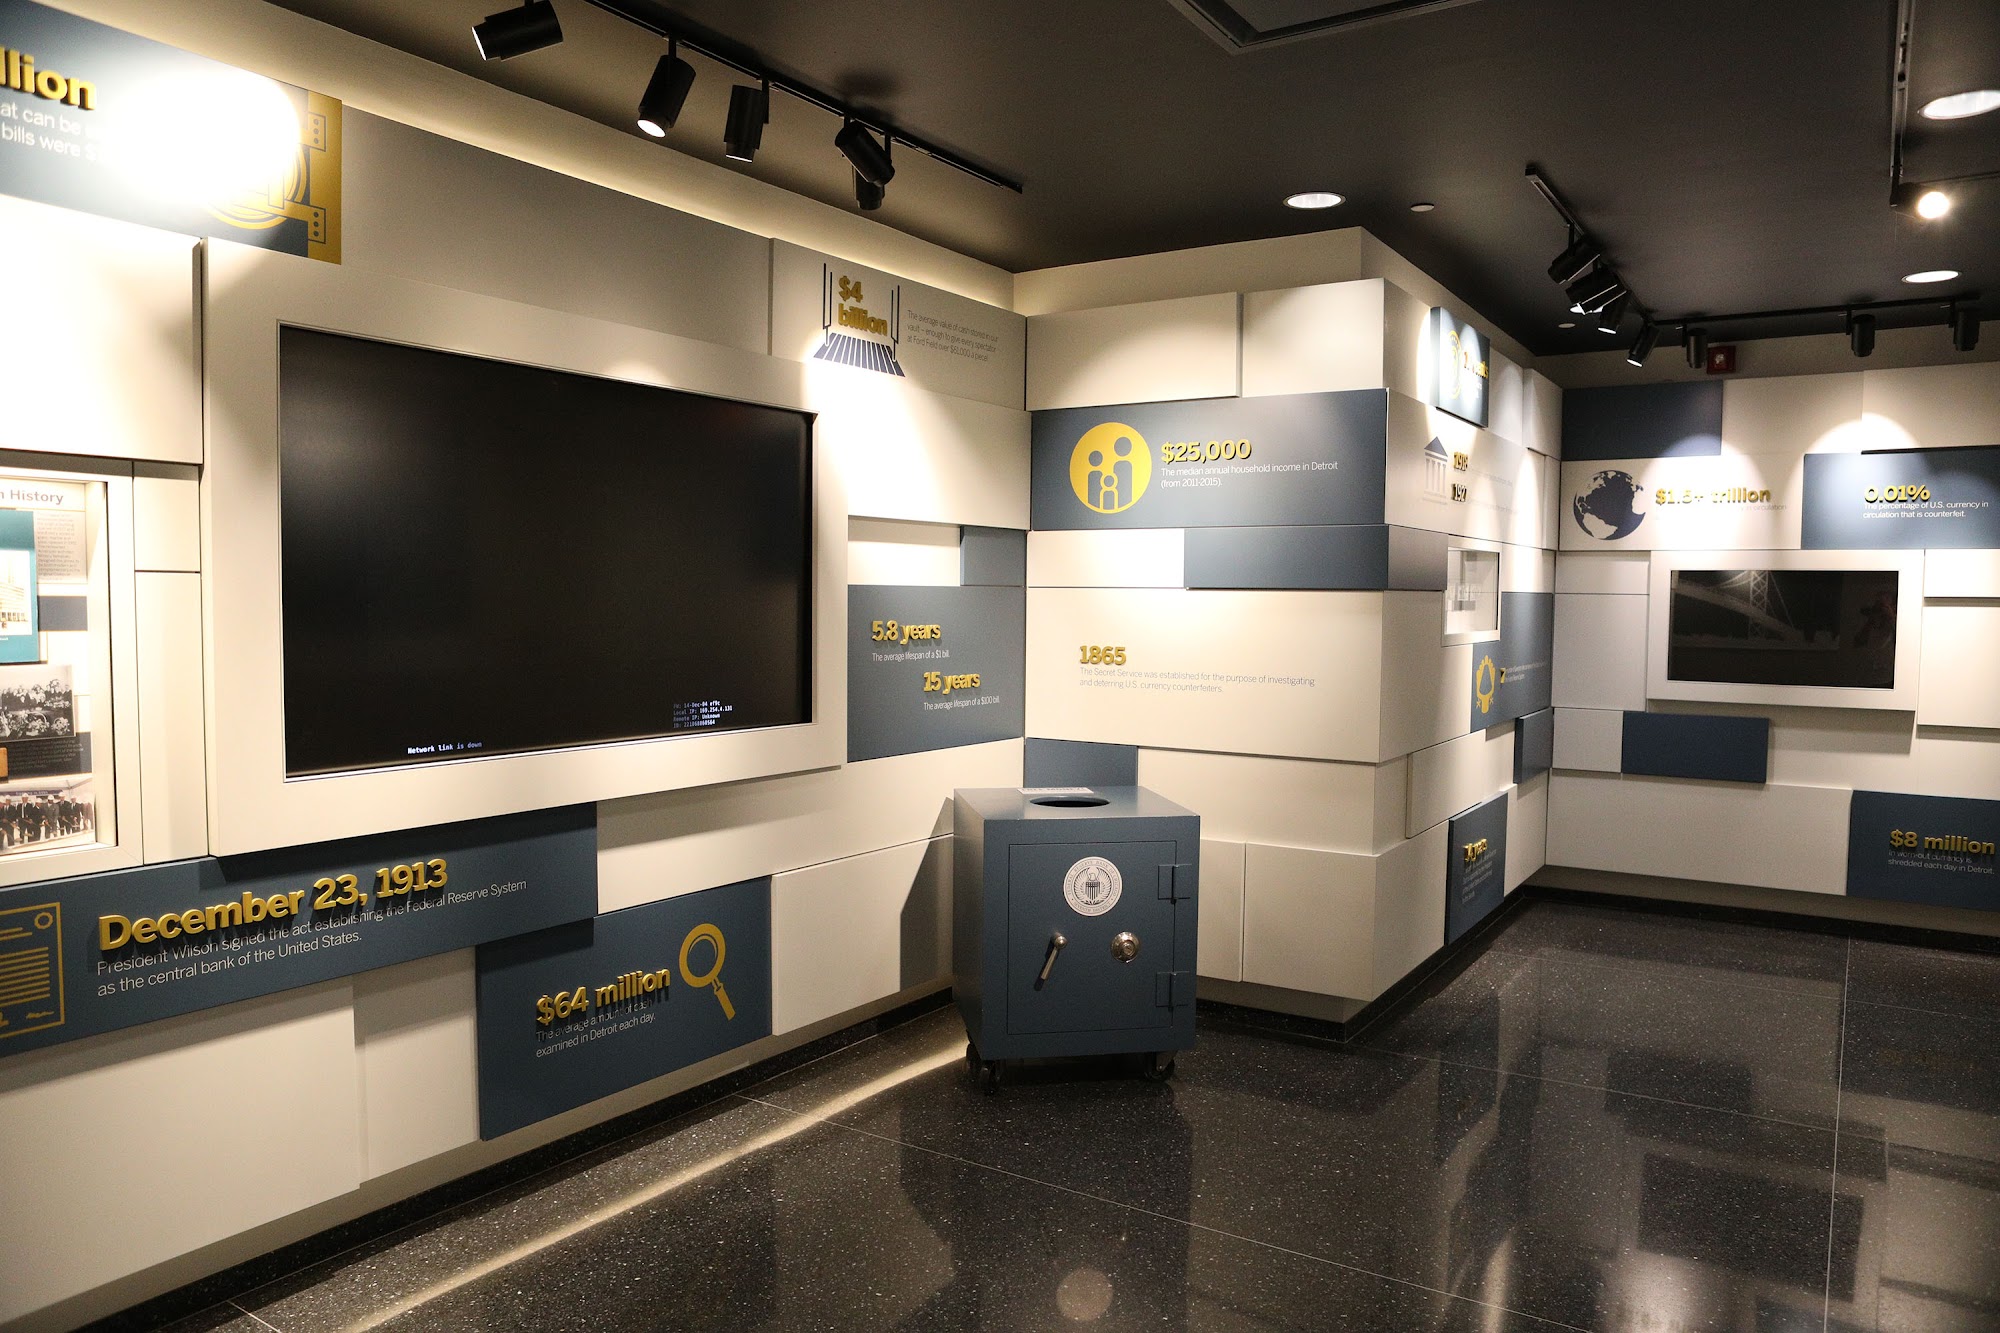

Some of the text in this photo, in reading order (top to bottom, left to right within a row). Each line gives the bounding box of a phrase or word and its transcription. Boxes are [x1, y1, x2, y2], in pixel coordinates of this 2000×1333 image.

[23, 108, 55, 129] can
[60, 114, 80, 135] be
[2, 122, 35, 146] bills
[40, 135, 80, 157] were
[839, 275, 863, 303] $4
[838, 303, 887, 337] billion
[907, 310, 918, 321] The
[918, 314, 938, 328] average
[939, 319, 952, 330] value
[953, 324, 958, 332] of
[959, 326, 970, 335] cash
[970, 329, 985, 340] stored
[907, 323, 997, 353] vault enough to give every spectator
[907, 335, 913, 343] at
[913, 336, 925, 346] Ford
[926, 339, 938, 350] Field
[939, 343, 949, 352] over
[1161, 439, 1252, 464] $25,000
[1161, 461, 1338, 477] The median annual household income in Detroit
[1160, 477, 1223, 489] (from 2011-2015).
[1864, 484, 1931, 503] 0.01%
[10, 489, 64, 505] History
[1711, 487, 1771, 503] trillion
[1879, 501, 1919, 510] percentage
[1920, 501, 1928, 509] of
[1930, 501, 1945, 509] U.S.
[1946, 501, 1980, 509] currency
[1981, 500, 1989, 508] in
[1863, 510, 1966, 519] circulation that is counterfeit.
[872, 620, 941, 645] 5.8 years
[872, 652, 883, 662] The
[883, 652, 904, 662] average
[905, 651, 924, 661] lifespan
[925, 650, 931, 659] of
[935, 649, 941, 659] $1
[1080, 645, 1126, 666] 1865
[923, 671, 981, 695] 15 years
[1080, 667, 1315, 687] The Secret Service was established for the purpose of investigating
[1080, 679, 1093, 687] and
[1093, 679, 1124, 689] deterring
[1125, 680, 1138, 689] U.S.
[1140, 682, 1171, 692] currency
[923, 702, 934, 711] The
[934, 700, 953, 711] average
[953, 699, 971, 709] lifespan
[971, 698, 977, 706] of
[981, 695, 992, 706] $100
[407, 741, 482, 754] Network link is down
[1890, 829, 1995, 855] $8 million
[1888, 859, 1922, 868] shredded
[1923, 862, 1942, 870] each
[1943, 863, 1957, 872] day
[1967, 865, 1995, 875] Detroit.
[1897, 851, 1930, 860] worn-out
[1932, 854, 1964, 864] currency
[99, 858, 448, 950] December 23, 1913
[97, 879, 527, 976] President Wilson signed the act establishing the Federal Reserve System
[97, 930, 362, 997] as the central bank of the United States.
[536, 968, 671, 1026] $64 million
[536, 1030, 557, 1042] The
[555, 1019, 589, 1037] average
[625, 1003, 632, 1015] of
[536, 1012, 656, 1058] examined in Detroit each day.
